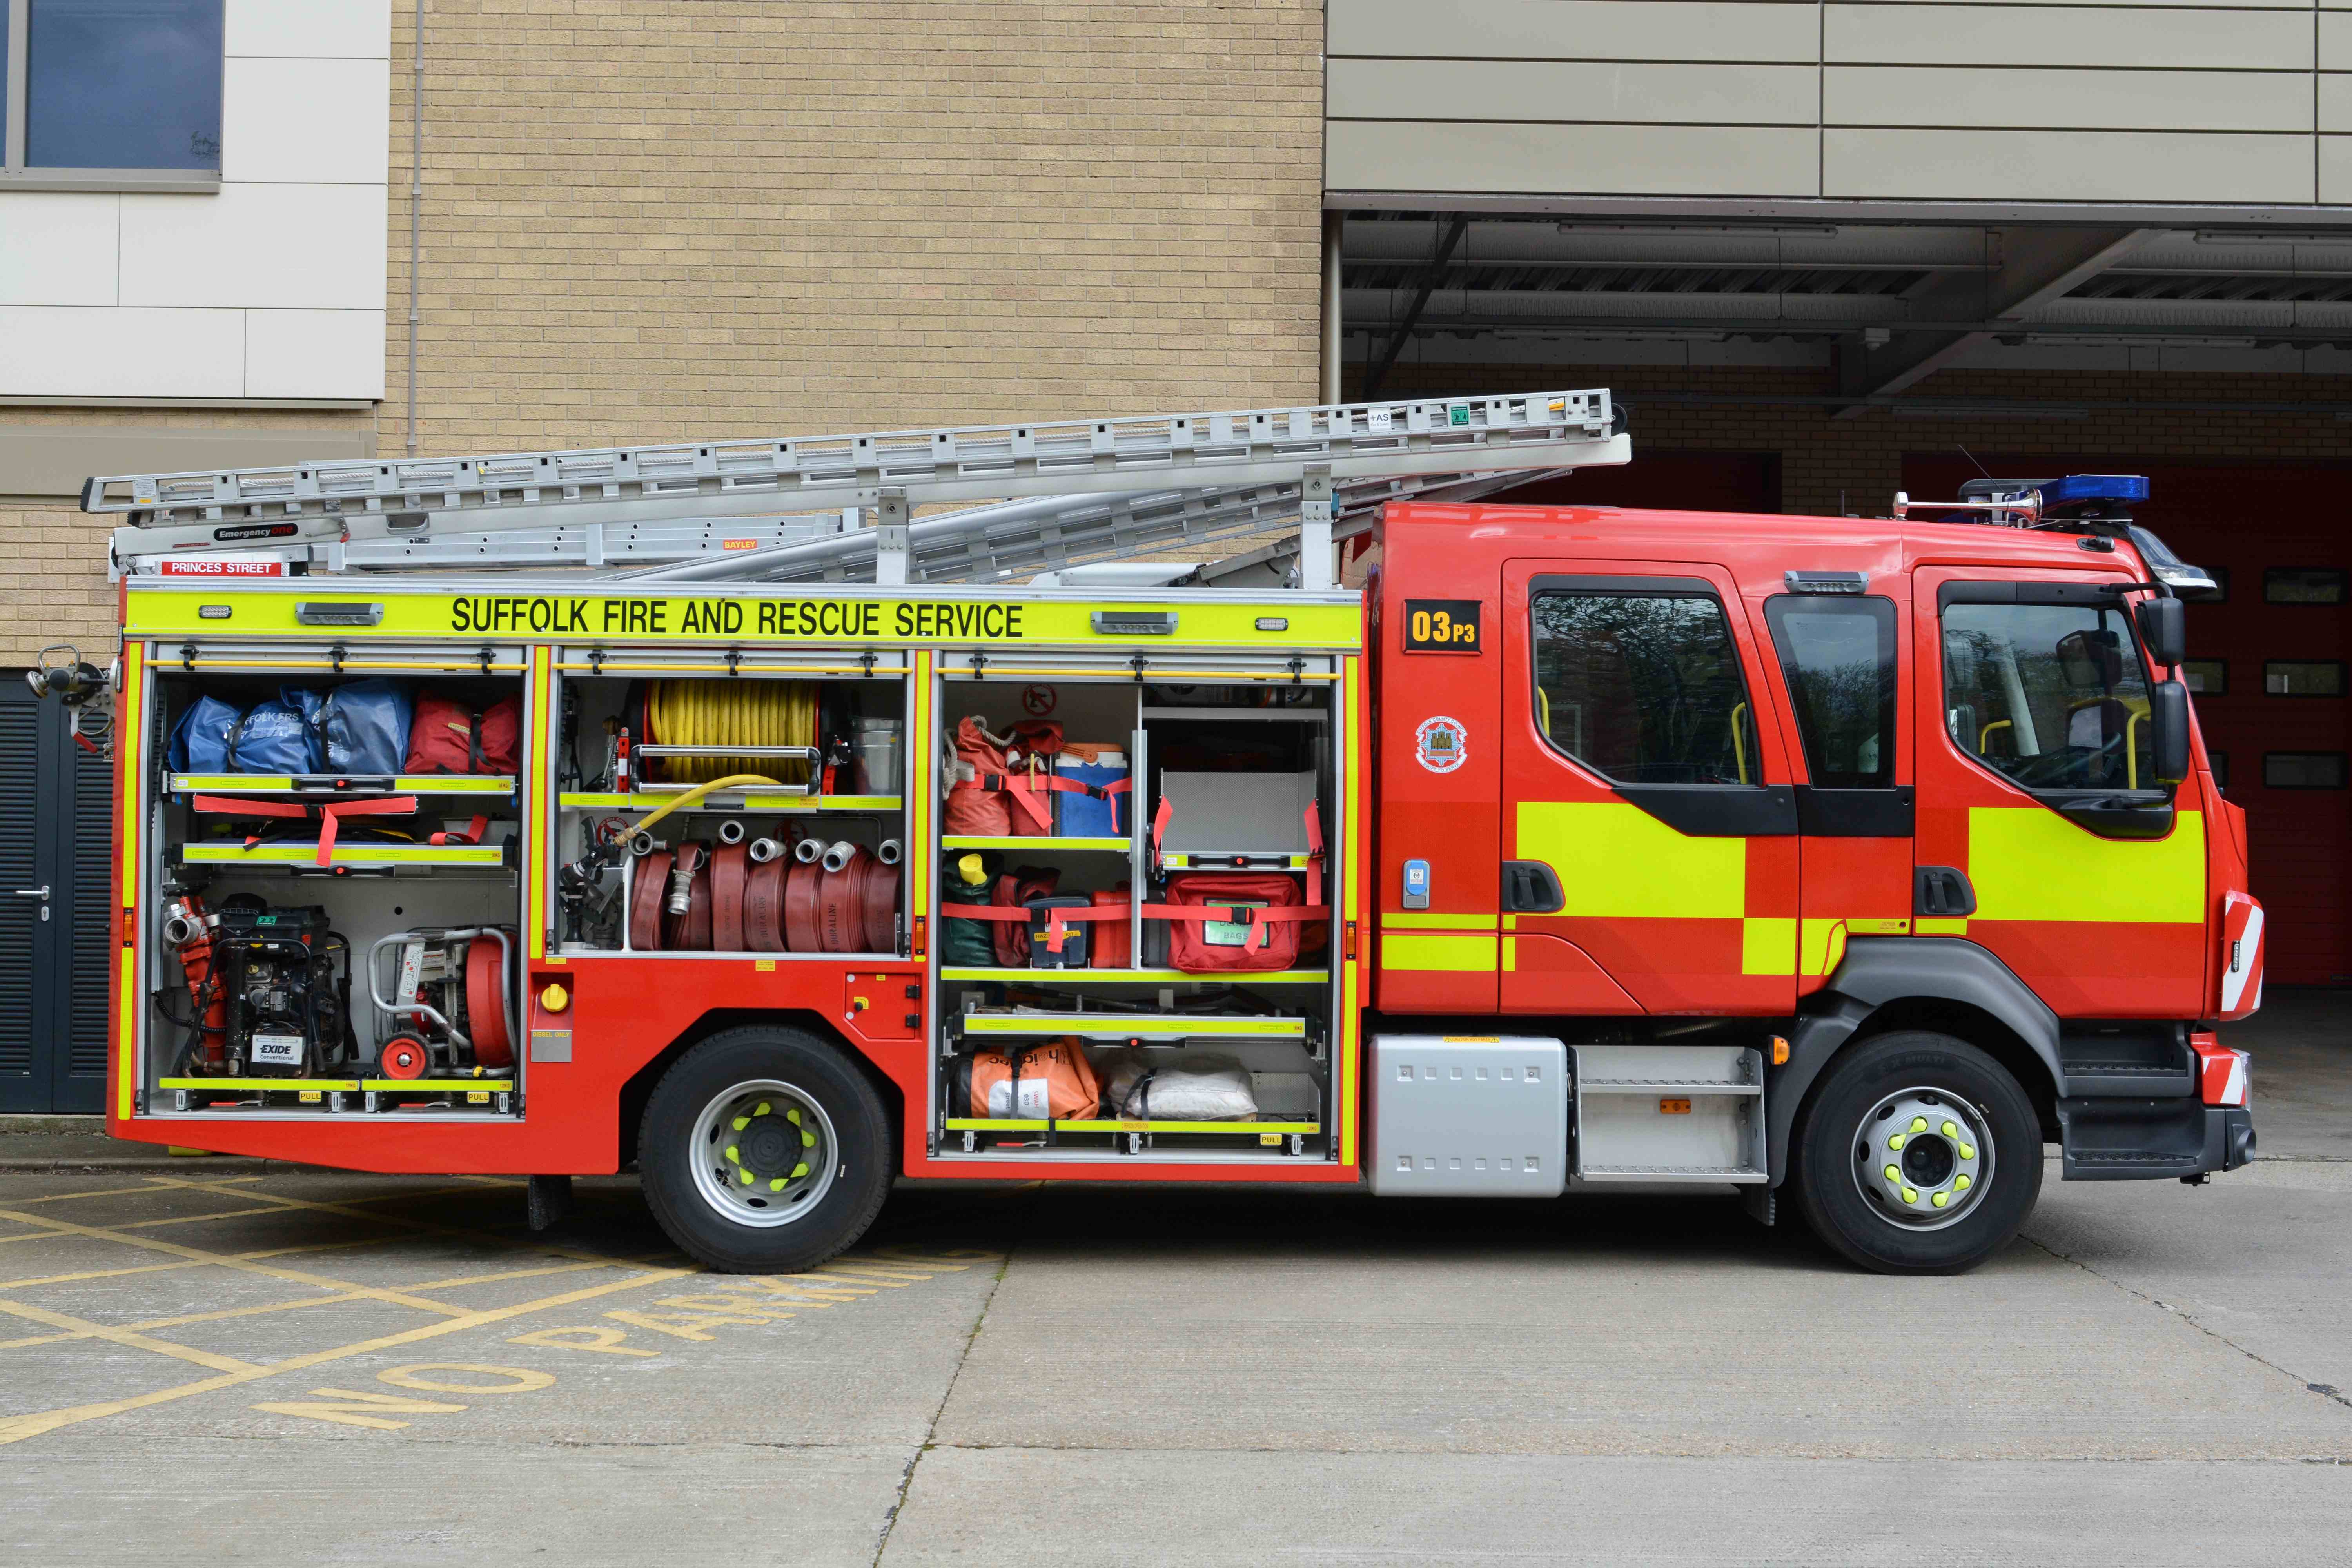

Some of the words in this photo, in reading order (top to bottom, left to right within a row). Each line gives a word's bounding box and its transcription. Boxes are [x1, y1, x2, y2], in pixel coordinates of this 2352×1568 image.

[219, 528, 271, 538] Emergency
[272, 526, 293, 534] one
[724, 541, 756, 549] BAYLEY
[172, 563, 221, 573] PRINCES
[227, 563, 272, 573] STREET
[452, 597, 588, 632] SUFFOLK
[604, 600, 666, 632] FIRE
[681, 601, 743, 633] AND
[759, 602, 880, 635] RESCUE
[895, 603, 1022, 637] SERVICE
[1417, 719, 1431, 734] SUFFOLK
[1451, 720, 1466, 734] COUNCIL
[828, 903, 840, 945] DURALINE
[260, 1045, 292, 1054] EXIDE
[249, 1363, 557, 1431] NO
